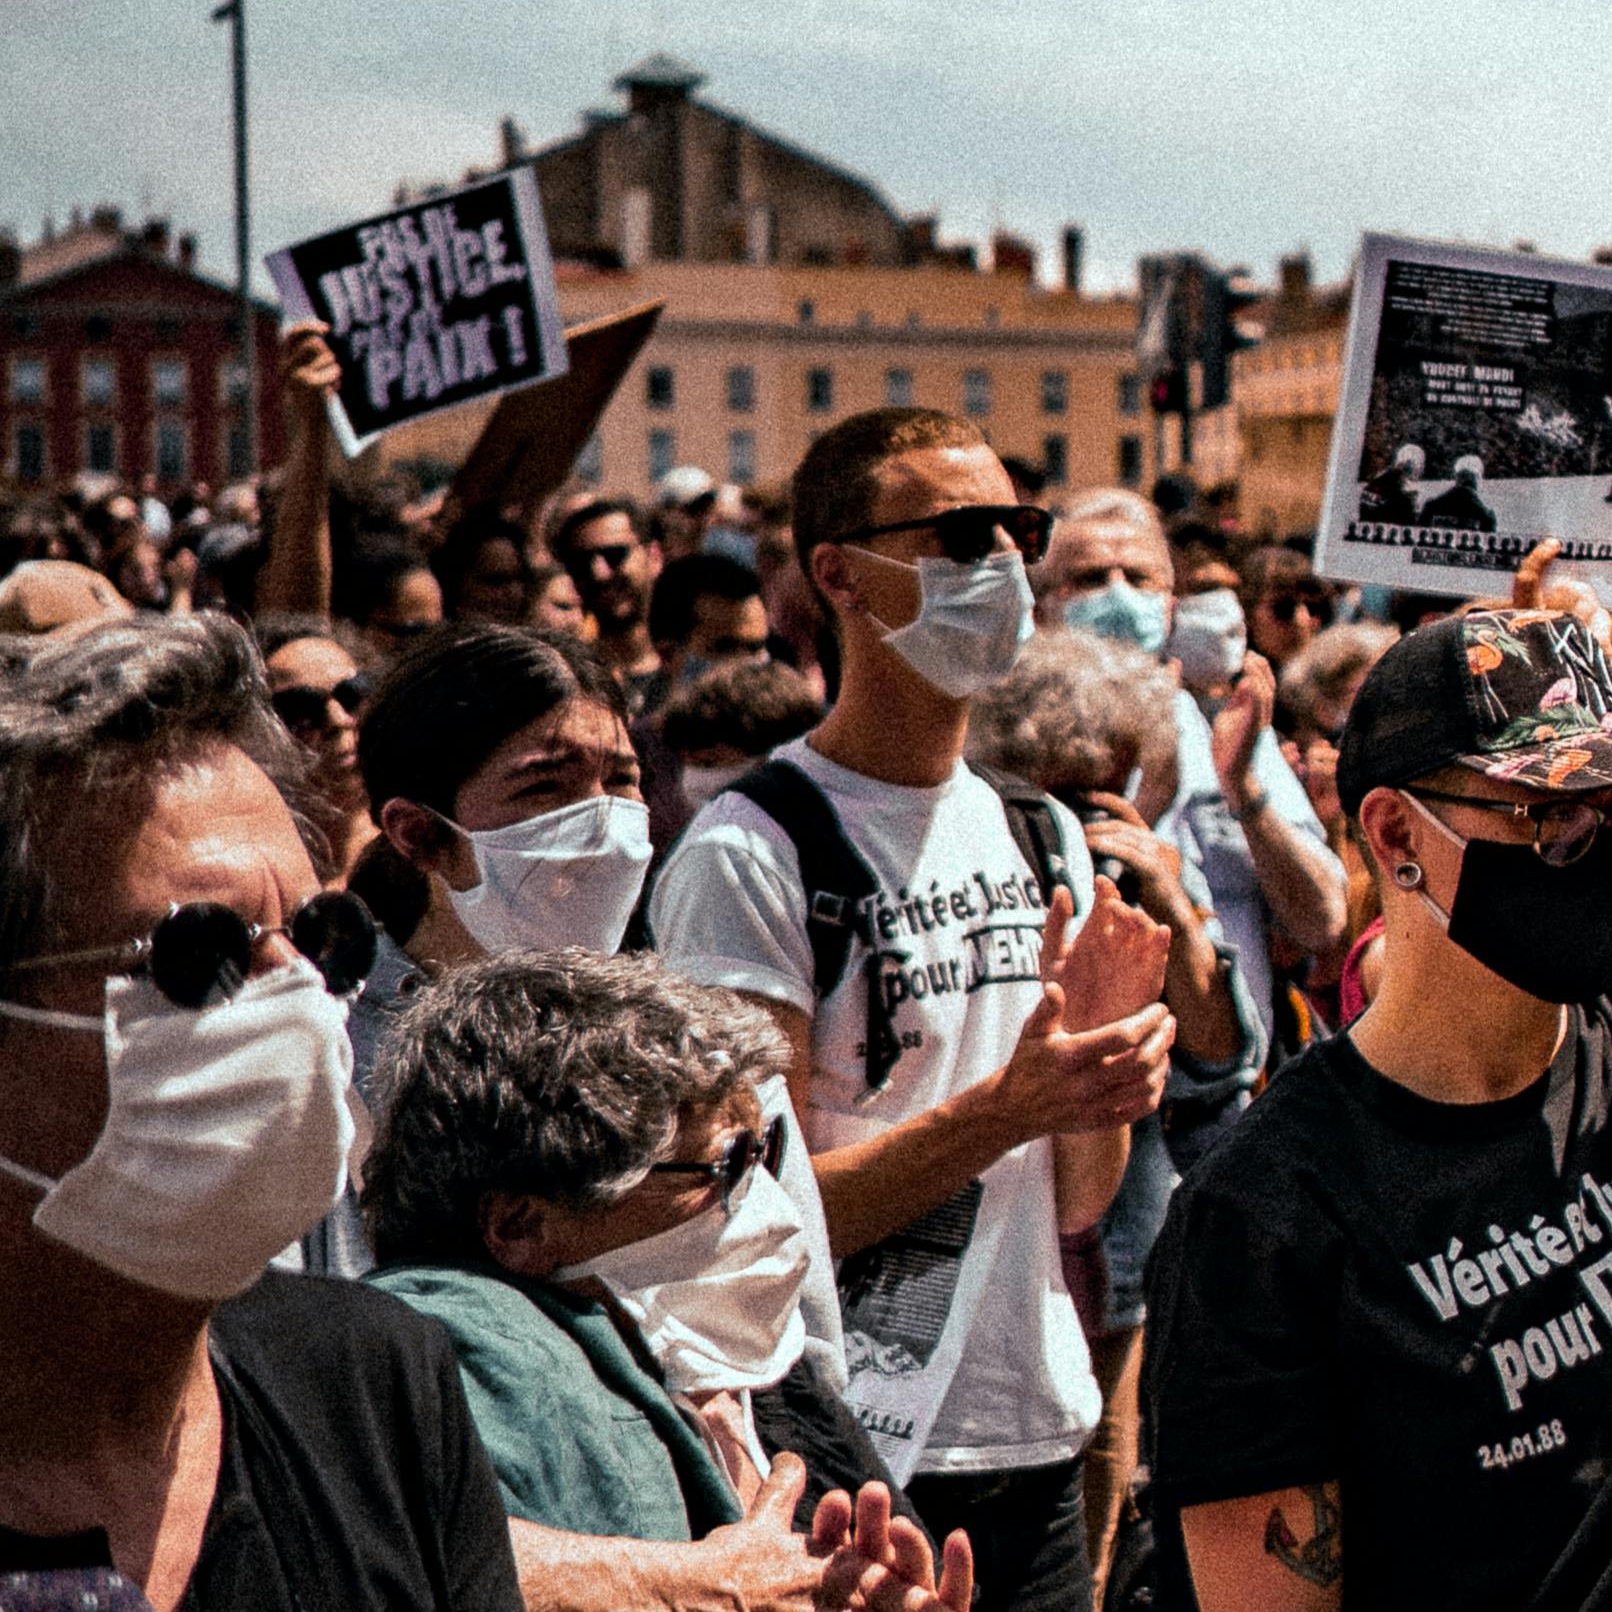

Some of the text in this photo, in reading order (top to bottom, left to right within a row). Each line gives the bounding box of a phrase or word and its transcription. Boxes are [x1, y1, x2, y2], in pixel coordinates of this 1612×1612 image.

[367, 305, 528, 410] PAIX !
[1408, 1215, 1575, 1321] Vérité
[1491, 1300, 1603, 1412] pour
[1478, 1419, 1567, 1469] 24.01.88
